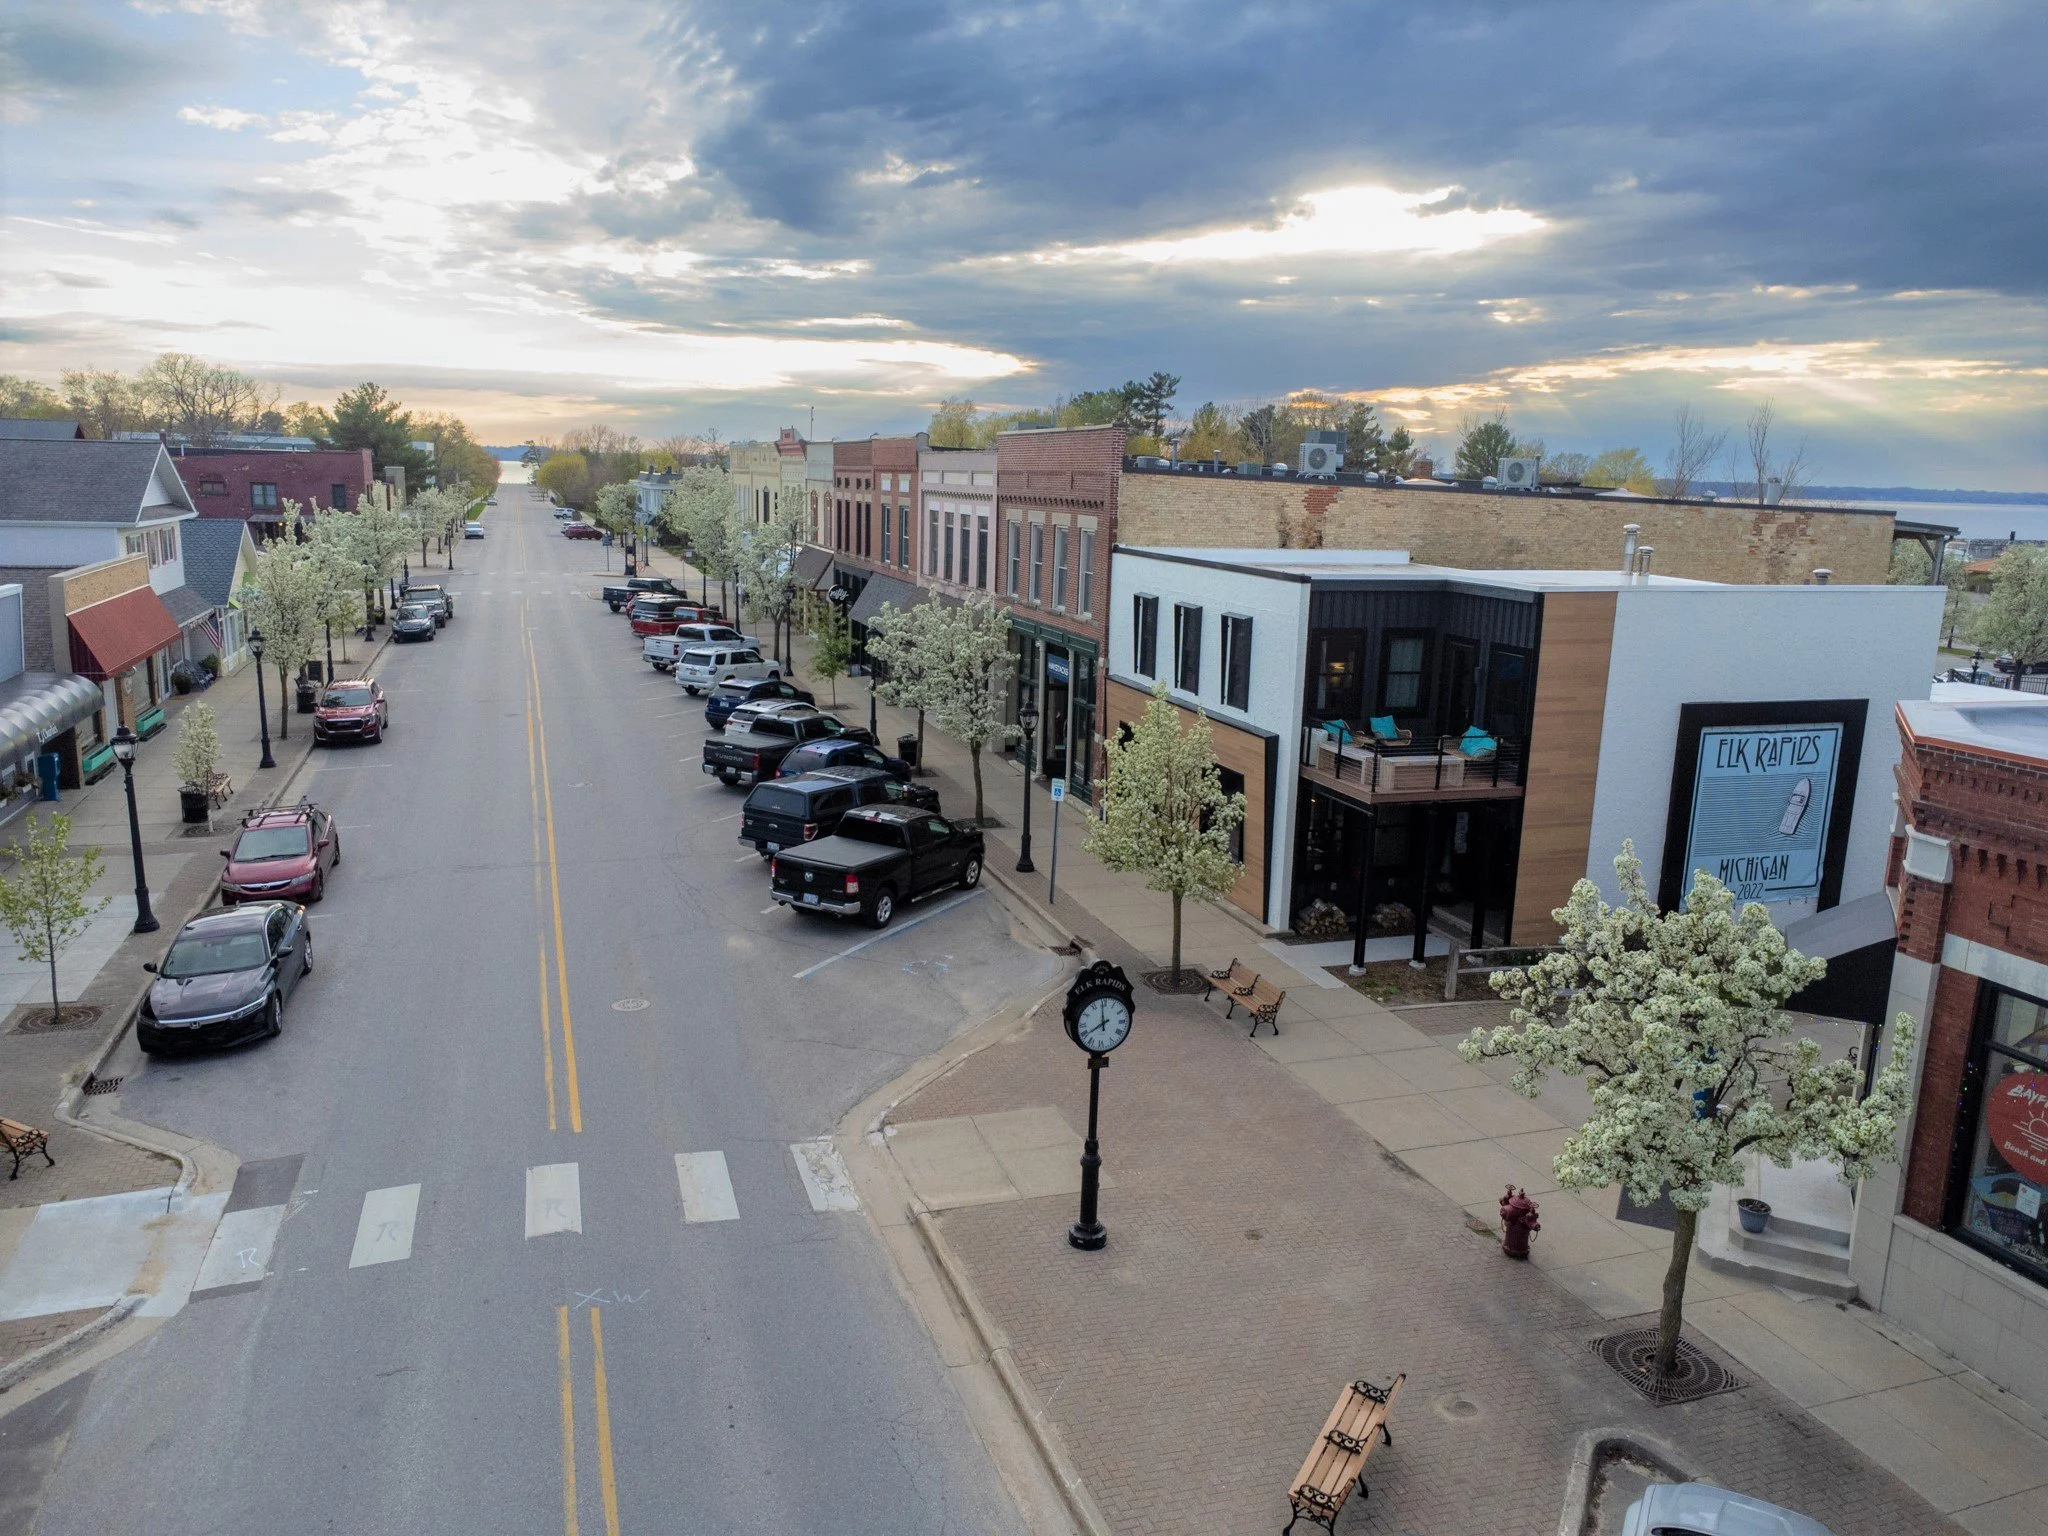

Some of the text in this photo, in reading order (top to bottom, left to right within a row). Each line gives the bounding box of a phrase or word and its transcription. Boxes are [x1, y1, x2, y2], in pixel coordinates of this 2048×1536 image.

[830, 588, 849, 600] nifty
[1716, 738, 1750, 773] ELK
[1736, 882, 1765, 900] 2022
[1074, 978, 1127, 995] ELK RAPIDS
[2007, 1084, 2048, 1108] BAYF
[2004, 1141, 2047, 1167] Beach and
